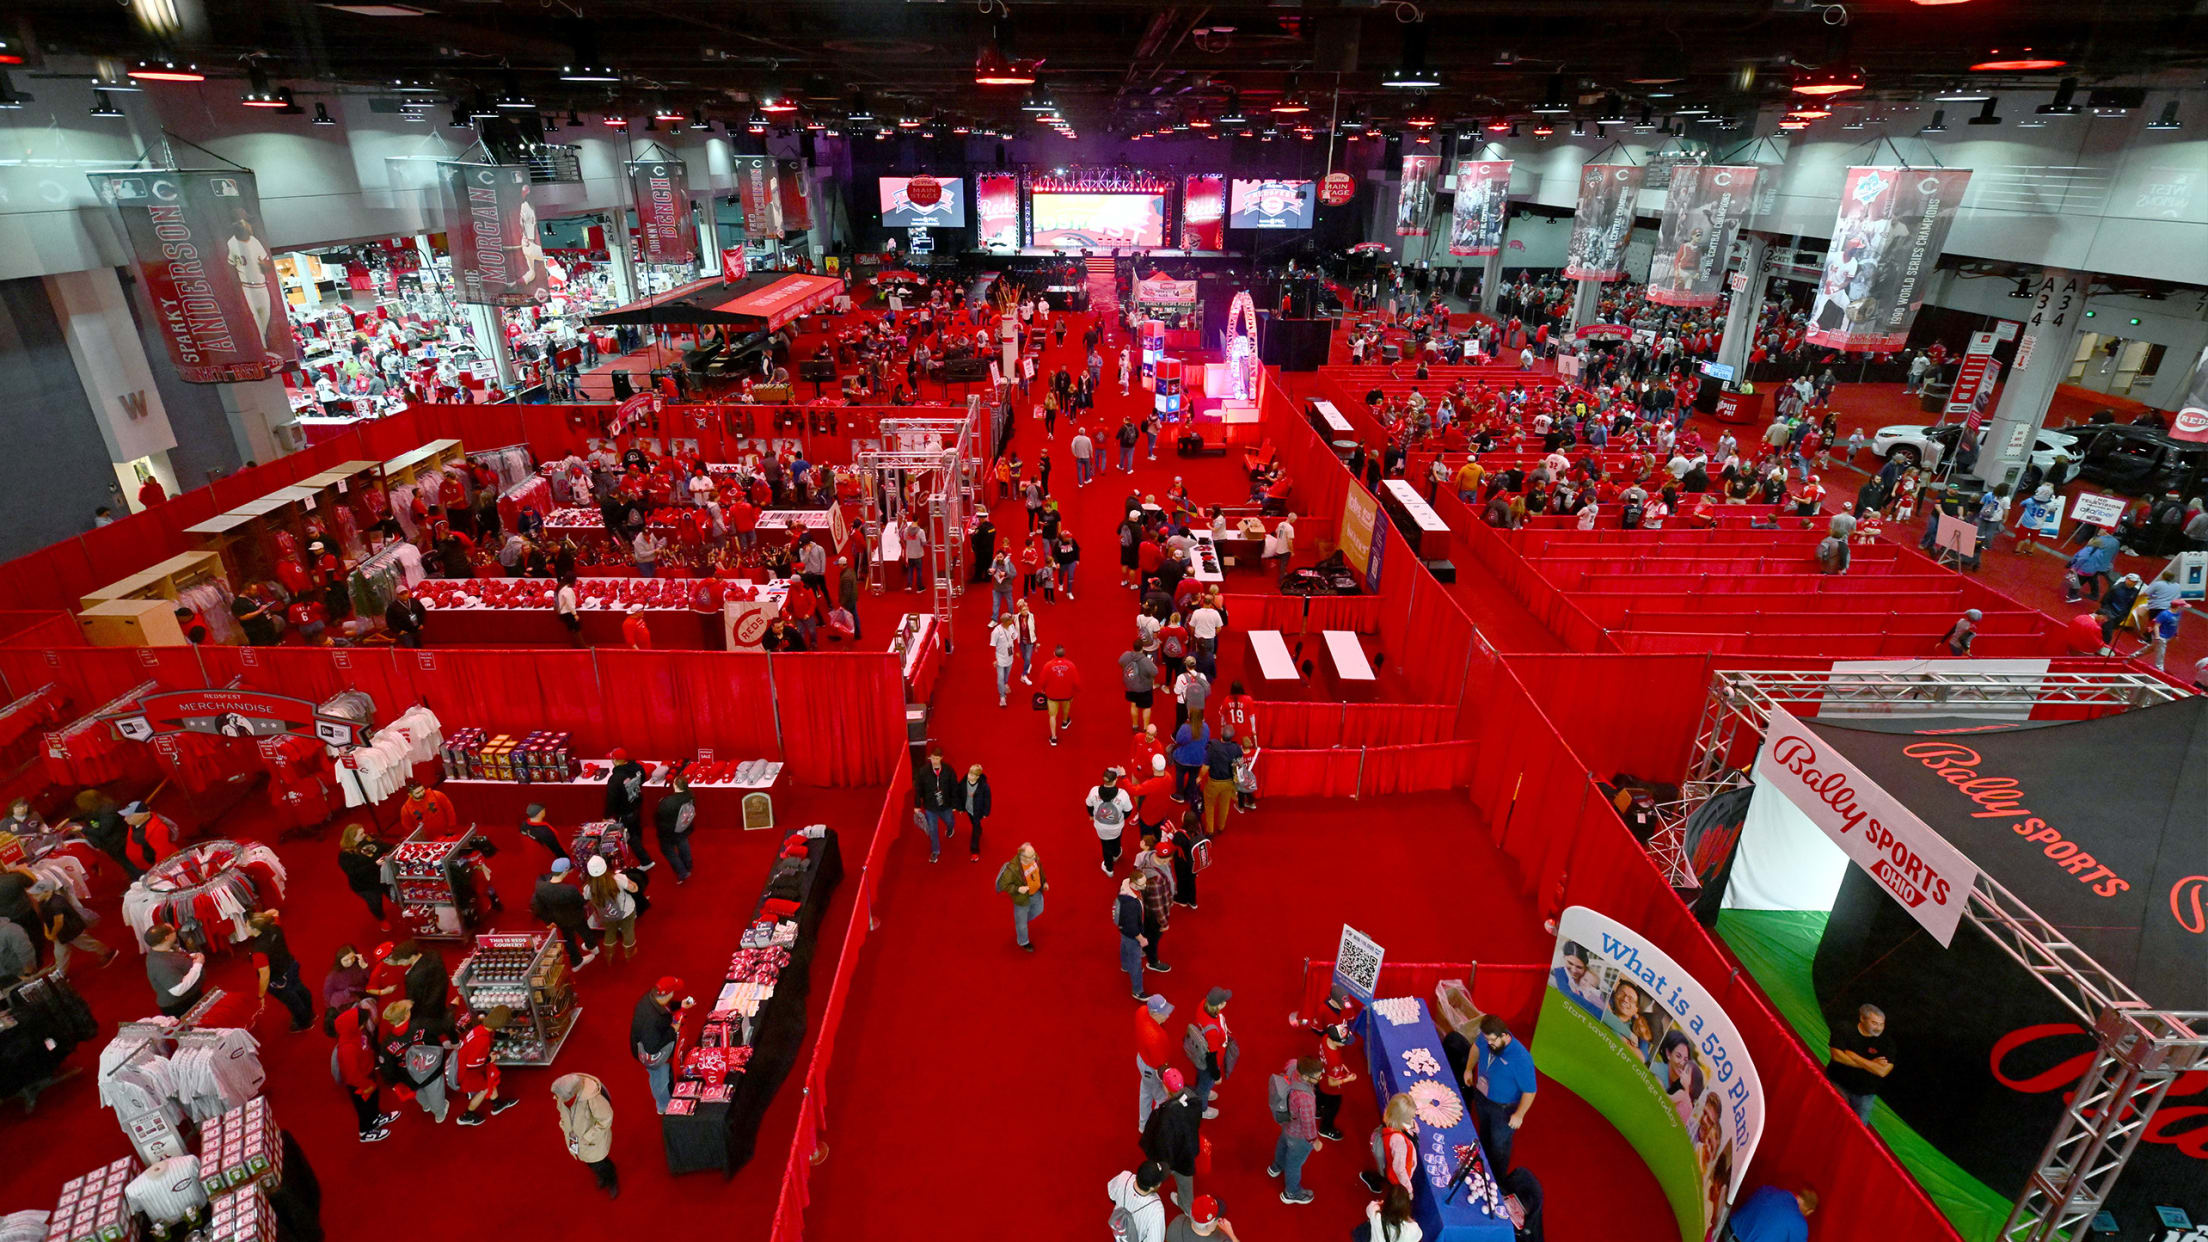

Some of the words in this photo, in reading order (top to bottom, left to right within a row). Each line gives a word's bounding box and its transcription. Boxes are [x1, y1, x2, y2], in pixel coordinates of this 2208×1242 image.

[650, 177, 678, 238] BENCH
[1714, 192, 1731, 227] CHAMPIONS
[468, 186, 511, 285] MORGAN
[1915, 198, 1940, 247] CHAMPIONS
[646, 222, 661, 253] JOHNNY
[1707, 228, 1722, 257] CENTRAL
[1906, 247, 1925, 276] SERIES
[148, 204, 237, 352] ANDERSON
[464, 268, 480, 288] JOE
[1733, 275, 1747, 290] EXIT
[1897, 277, 1916, 306] WORLD
[1890, 305, 1905, 325] 1990
[160, 298, 199, 363] SPARKY
[1549, 461, 1558, 469] 32
[2031, 507, 2046, 518] 18
[301, 611, 309, 621] 6
[741, 617, 764, 640] REDS
[179, 702, 275, 714] MERCHANDISE
[1230, 709, 1244, 723] 19
[1773, 735, 1867, 834] Bally
[1865, 819, 1951, 906] SPORTS
[1903, 742, 2032, 818] Bally
[2012, 817, 2130, 897] SPORTS
[2, 847, 18, 857] SALE
[1880, 864, 1916, 903] OHIO
[1601, 932, 1668, 995] What
[1667, 987, 1690, 1016] is
[1689, 1015, 1704, 1035] a
[1702, 1032, 1733, 1083] 529
[1562, 1000, 1588, 1023] Start
[1588, 1021, 1618, 1051] saving
[1616, 1047, 1632, 1065] for
[1632, 1063, 1659, 1097] college
[1658, 1095, 1679, 1128] today
